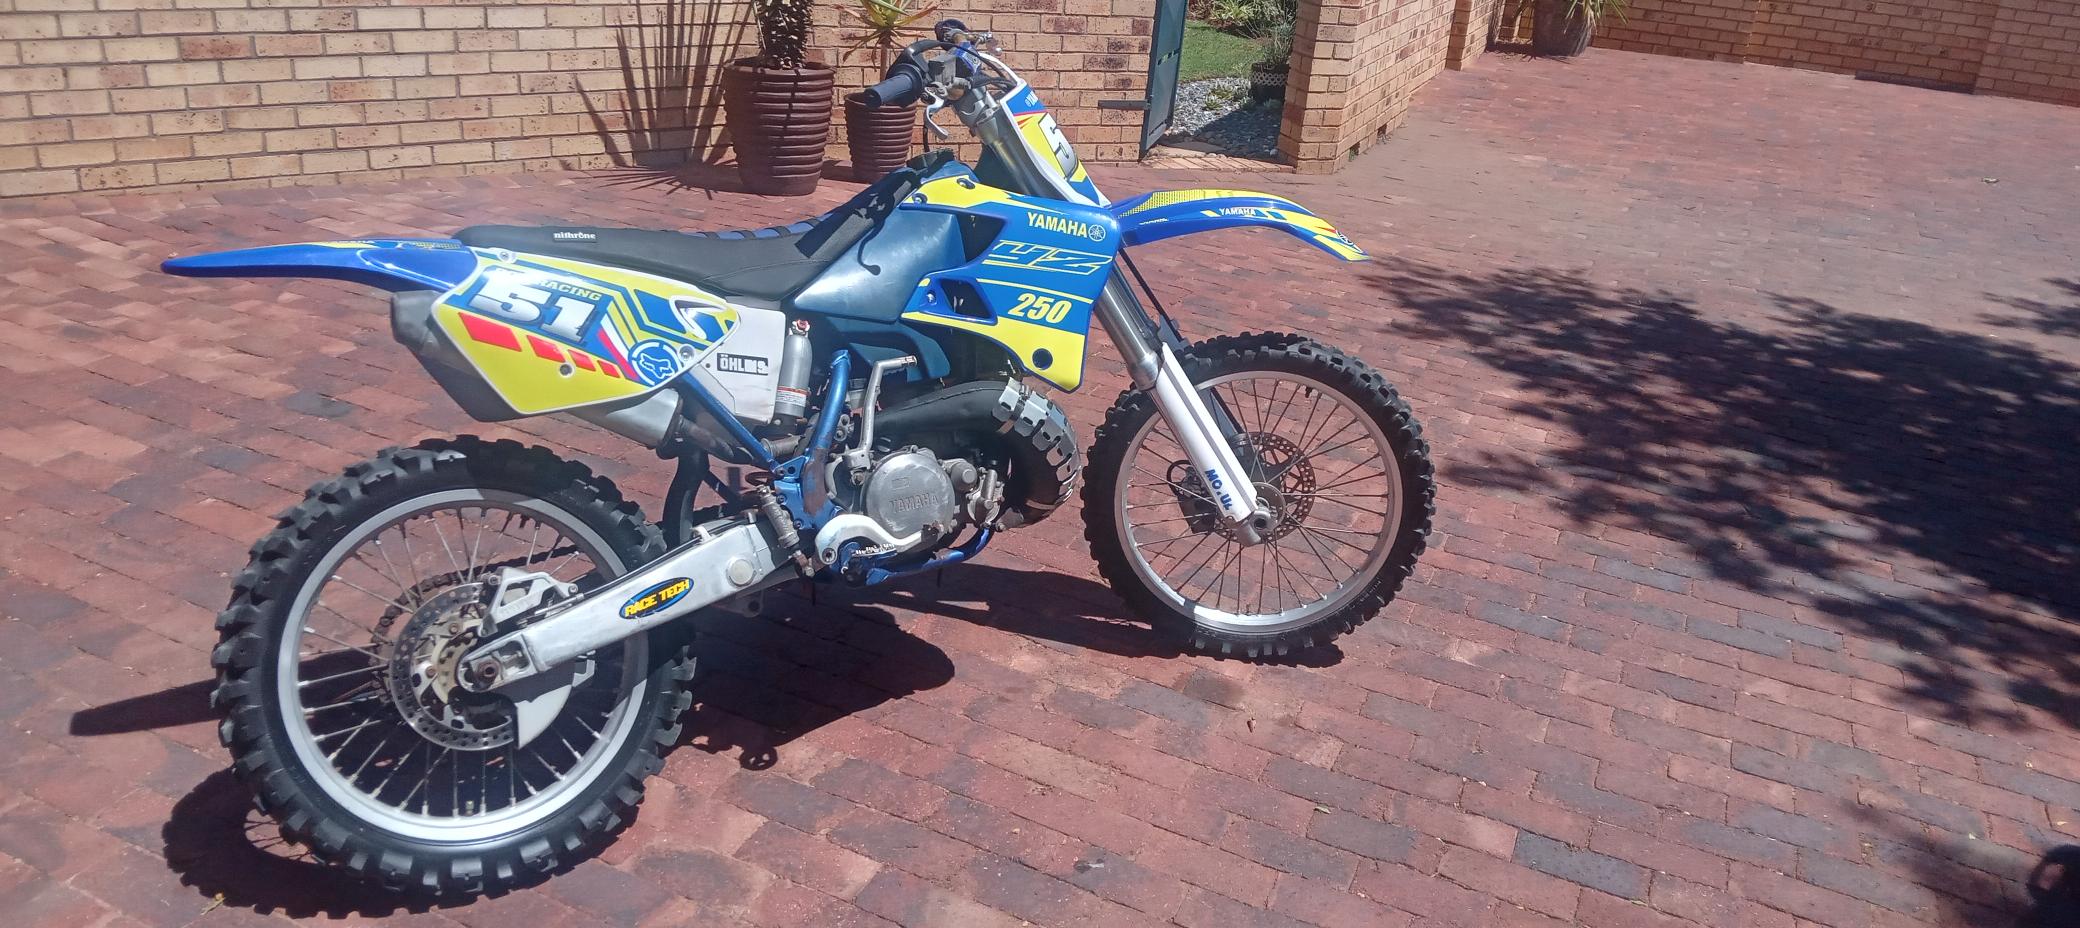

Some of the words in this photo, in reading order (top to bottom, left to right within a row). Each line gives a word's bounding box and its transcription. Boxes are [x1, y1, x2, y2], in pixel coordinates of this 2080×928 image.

[1027, 212, 1088, 238] YAMAHA
[1219, 207, 1256, 216] YAMAHA
[468, 268, 597, 343] 51
[1007, 293, 1072, 324] 250
[720, 354, 769, 375] ÖHLS
[625, 594, 658, 617] RACE
[659, 579, 690, 601] TECH
